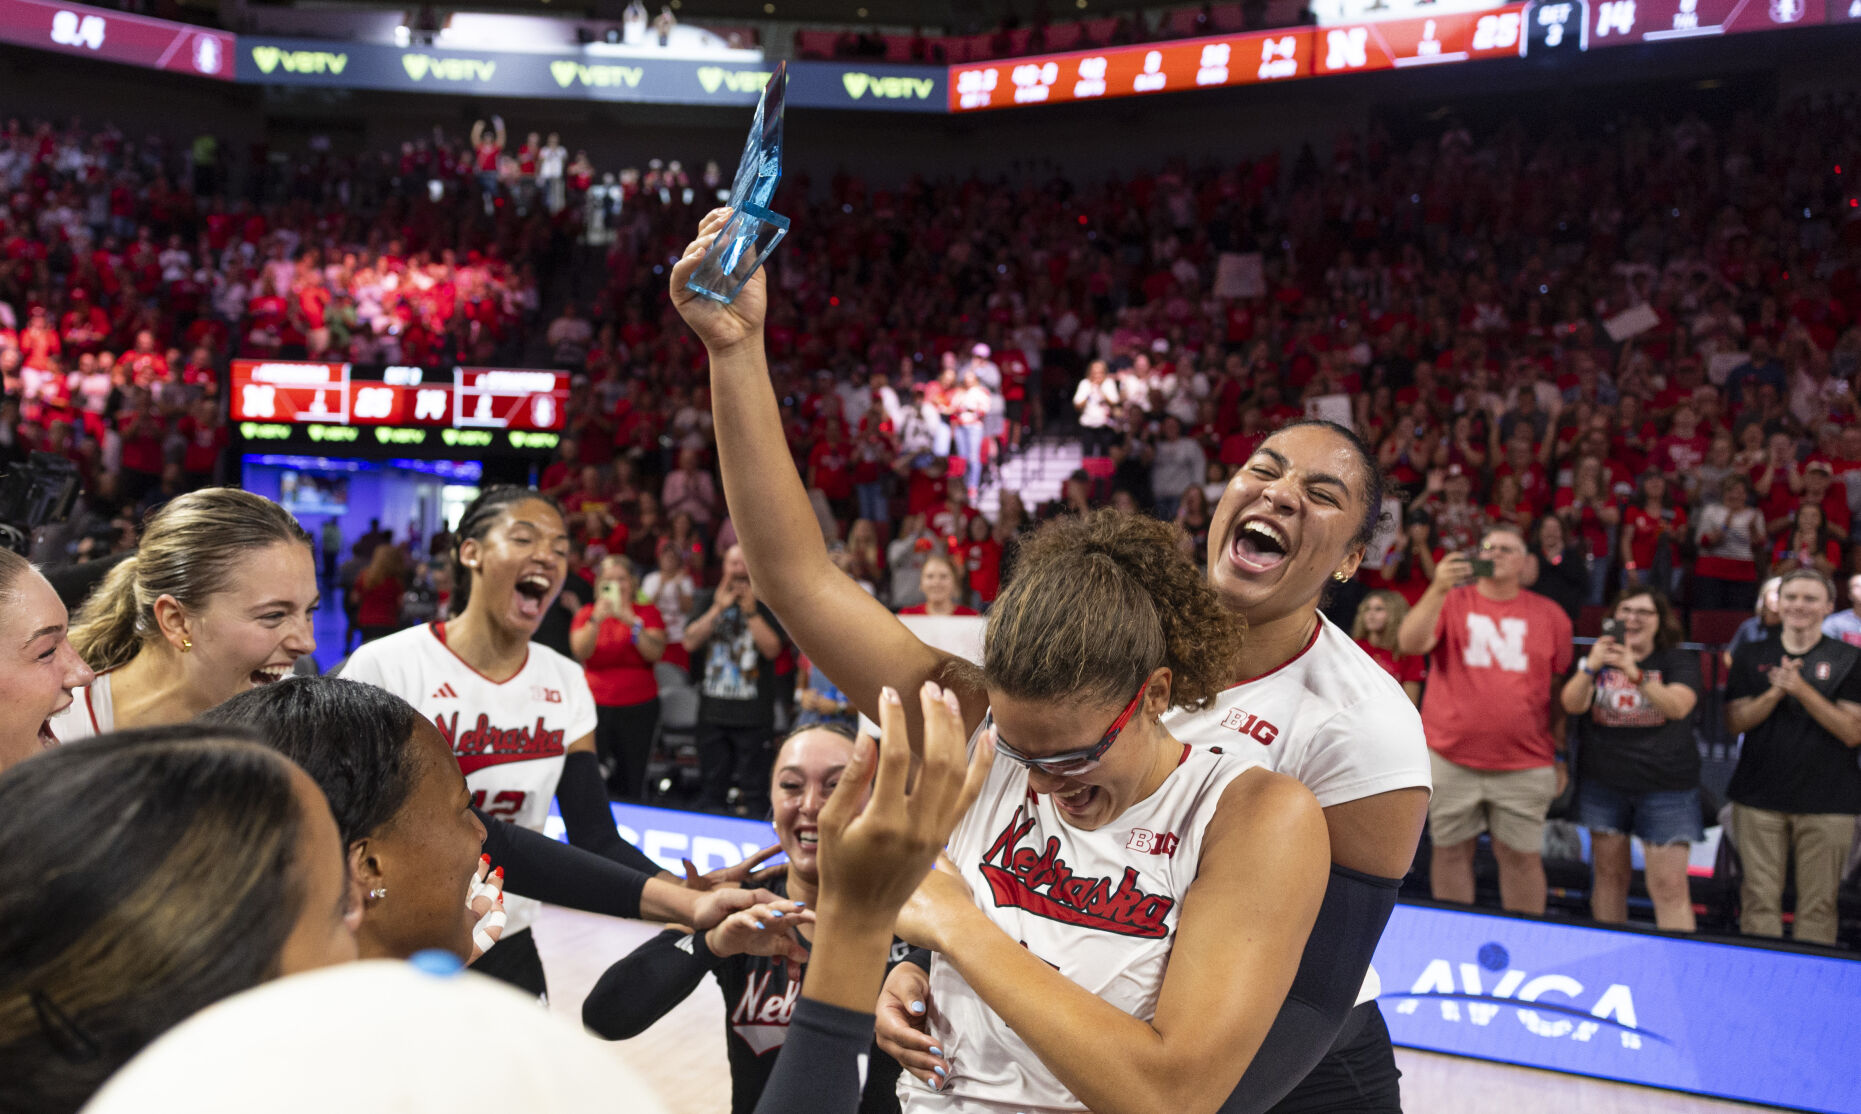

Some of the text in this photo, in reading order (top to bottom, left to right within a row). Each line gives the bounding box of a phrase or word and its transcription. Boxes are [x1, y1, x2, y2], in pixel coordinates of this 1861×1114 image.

[1326, 27, 1369, 69] N
[1464, 612, 1529, 672] N
[981, 804, 1175, 930] Nebraska
[1395, 958, 1643, 1050] AVCA
